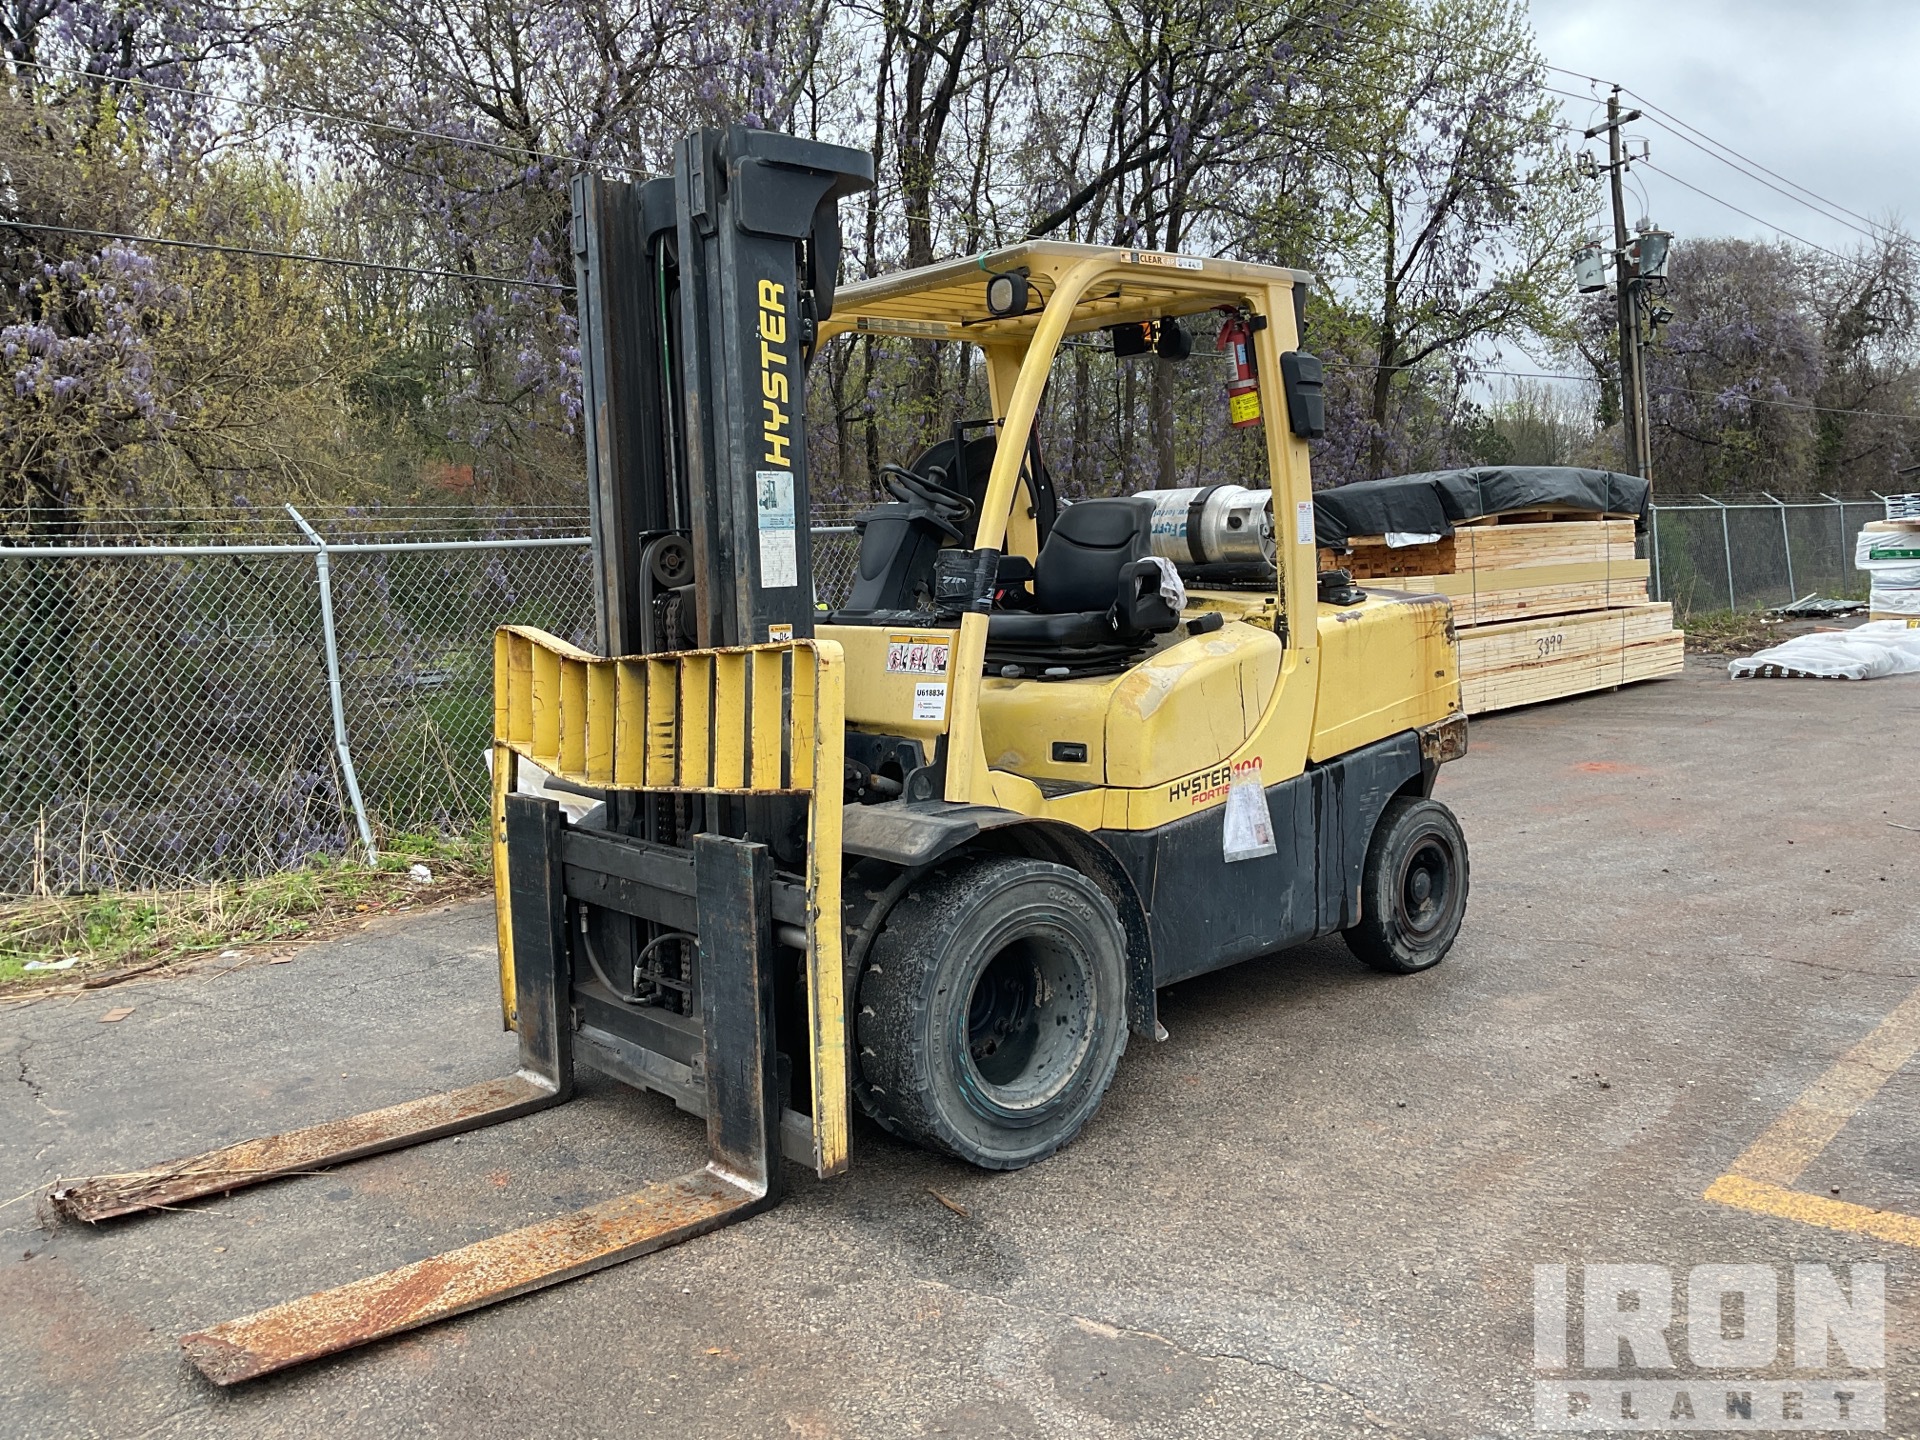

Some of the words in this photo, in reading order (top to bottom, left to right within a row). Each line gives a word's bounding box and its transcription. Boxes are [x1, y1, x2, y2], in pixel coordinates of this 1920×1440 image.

[758, 279, 790, 467] HYSTER
[1535, 634, 1563, 659] 3899
[1170, 767, 1231, 802] HYSTER
[1234, 756, 1263, 778] 100
[1191, 783, 1231, 806] FORTIS
[1047, 886, 1094, 921] 8.25-15
